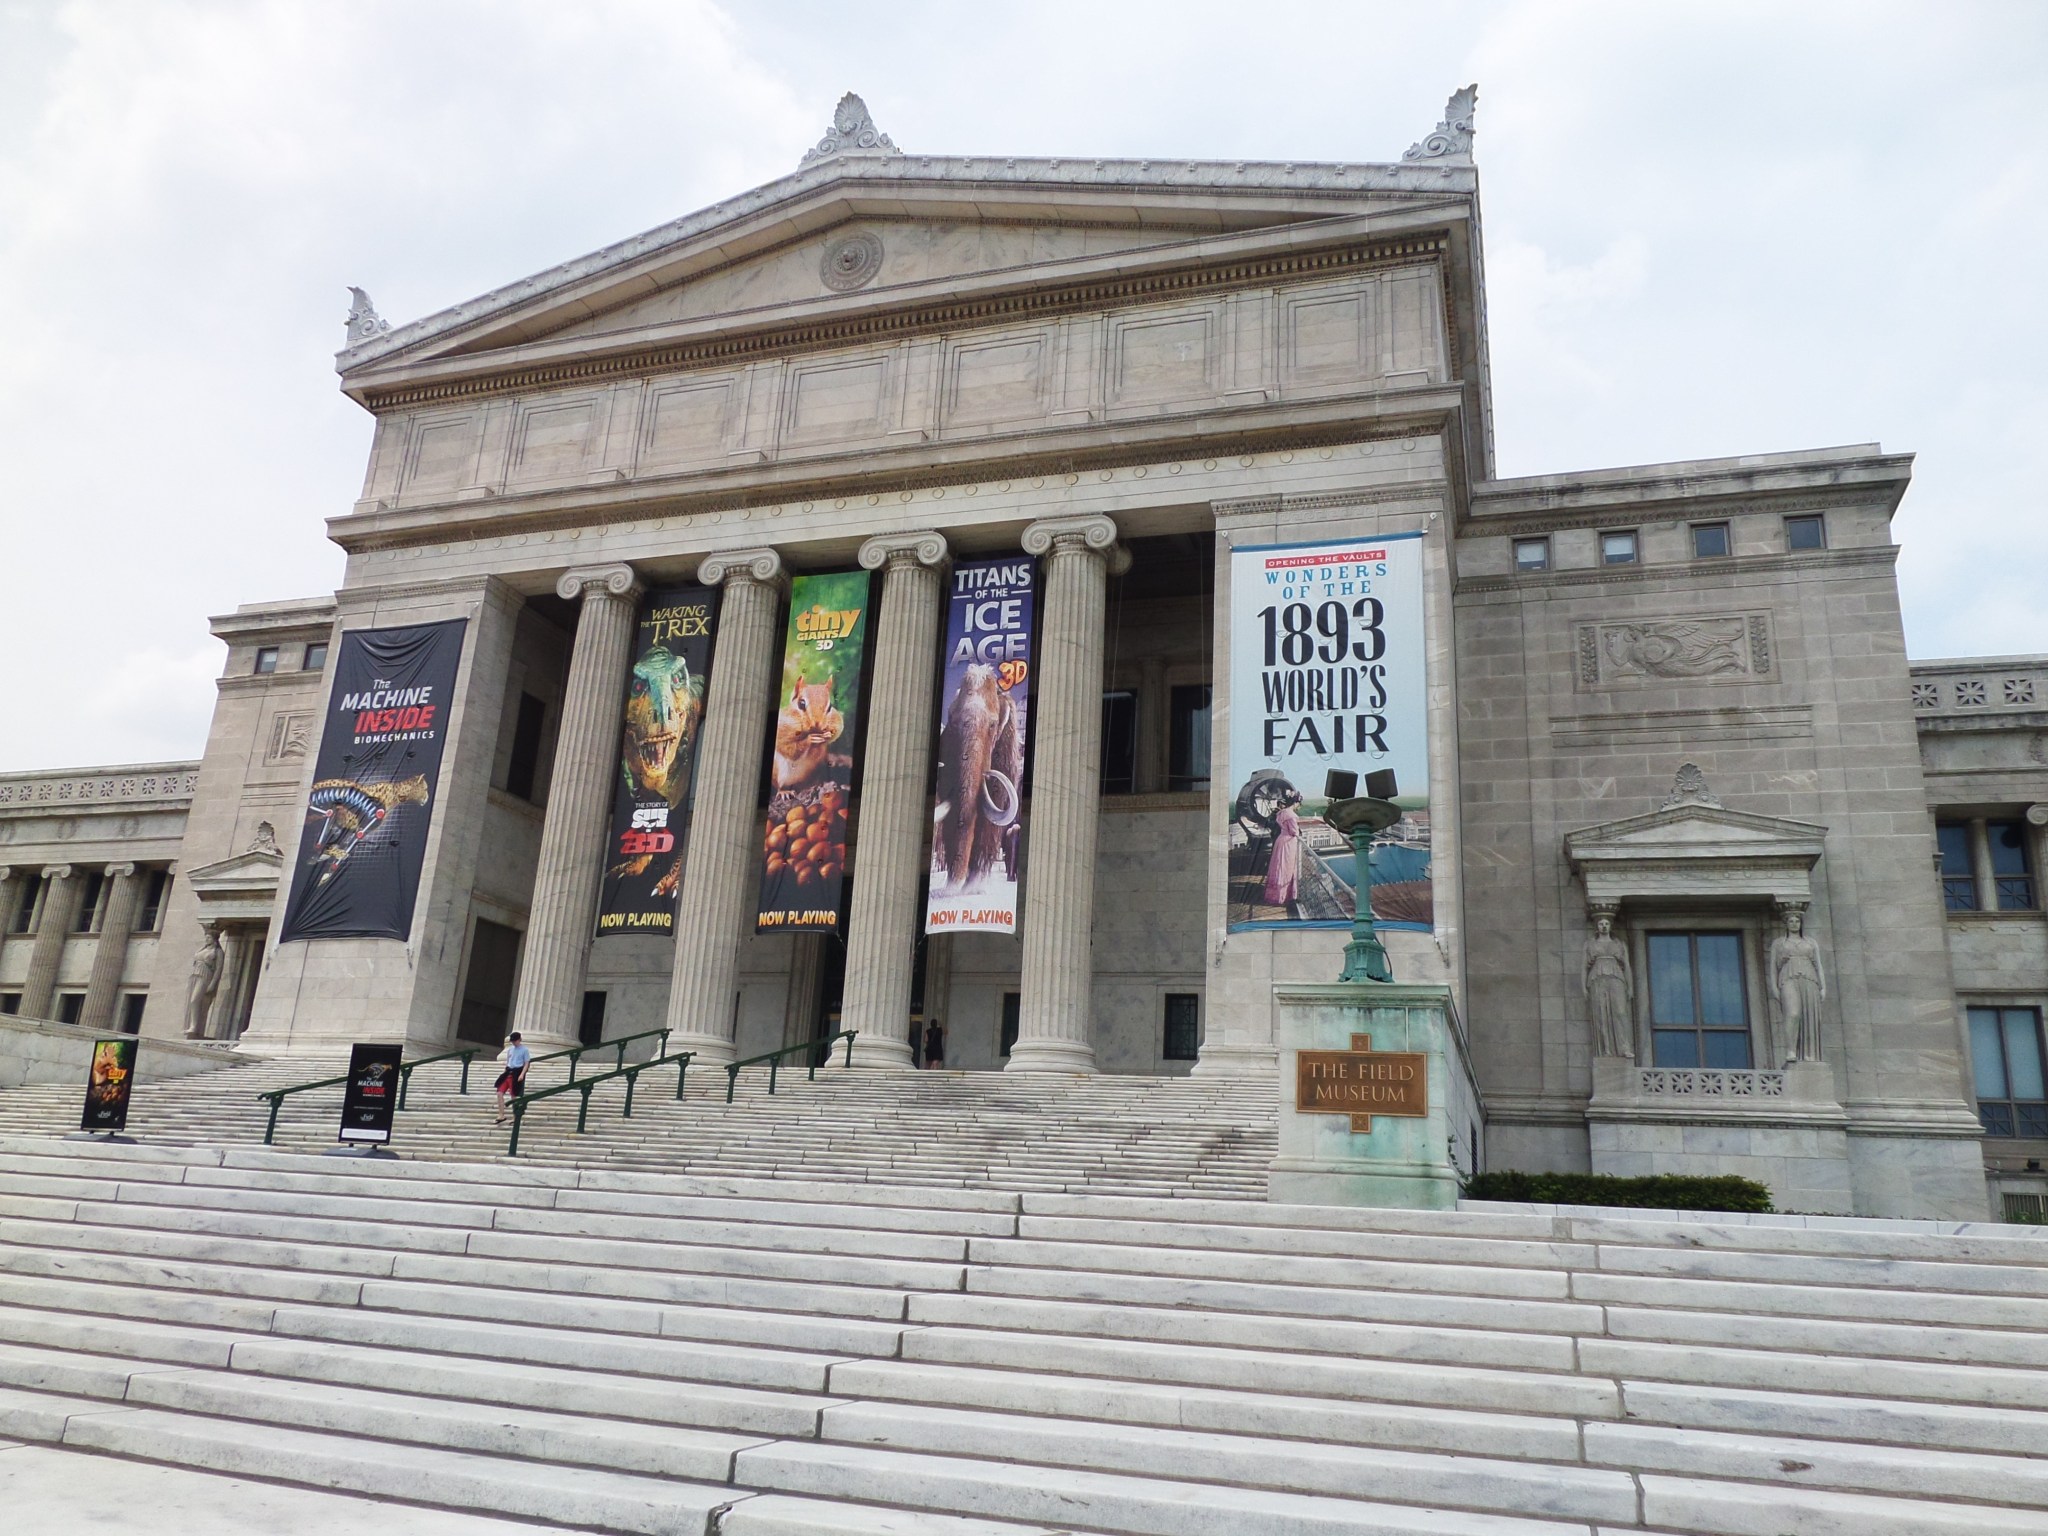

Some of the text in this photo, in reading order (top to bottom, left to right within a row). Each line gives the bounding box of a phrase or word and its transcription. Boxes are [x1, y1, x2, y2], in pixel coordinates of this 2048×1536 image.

[1268, 552, 1383, 567] OPENING THE VAULTS
[955, 564, 1031, 592] TITANS
[1265, 563, 1387, 585] WONDERS
[975, 587, 1009, 599] OF THE
[1282, 580, 1371, 599] OF THE
[652, 605, 707, 620] WAKING
[795, 604, 861, 638] tiny
[964, 599, 1022, 633] ICE
[797, 629, 840, 641] GIANTS
[1257, 597, 1386, 666] 1893
[815, 640, 834, 651] 3D
[950, 633, 1027, 666] AGE
[373, 679, 391, 690] The
[997, 659, 1028, 691] 3D
[340, 686, 433, 711] MACHINE
[1262, 664, 1387, 713] WORLD'S
[354, 705, 436, 733] INSIDE
[354, 731, 435, 744] BIOMECHANICS
[1264, 714, 1390, 757] FAIR
[631, 808, 669, 829] SUE
[620, 831, 675, 854] 3D
[601, 912, 672, 928] NOW PLAYING
[759, 910, 836, 926] NOW PLAYING
[930, 910, 1013, 926] NOW PLAYING
[1308, 1062, 1414, 1081] THE FIELD
[1316, 1084, 1405, 1103] MUSEUM
